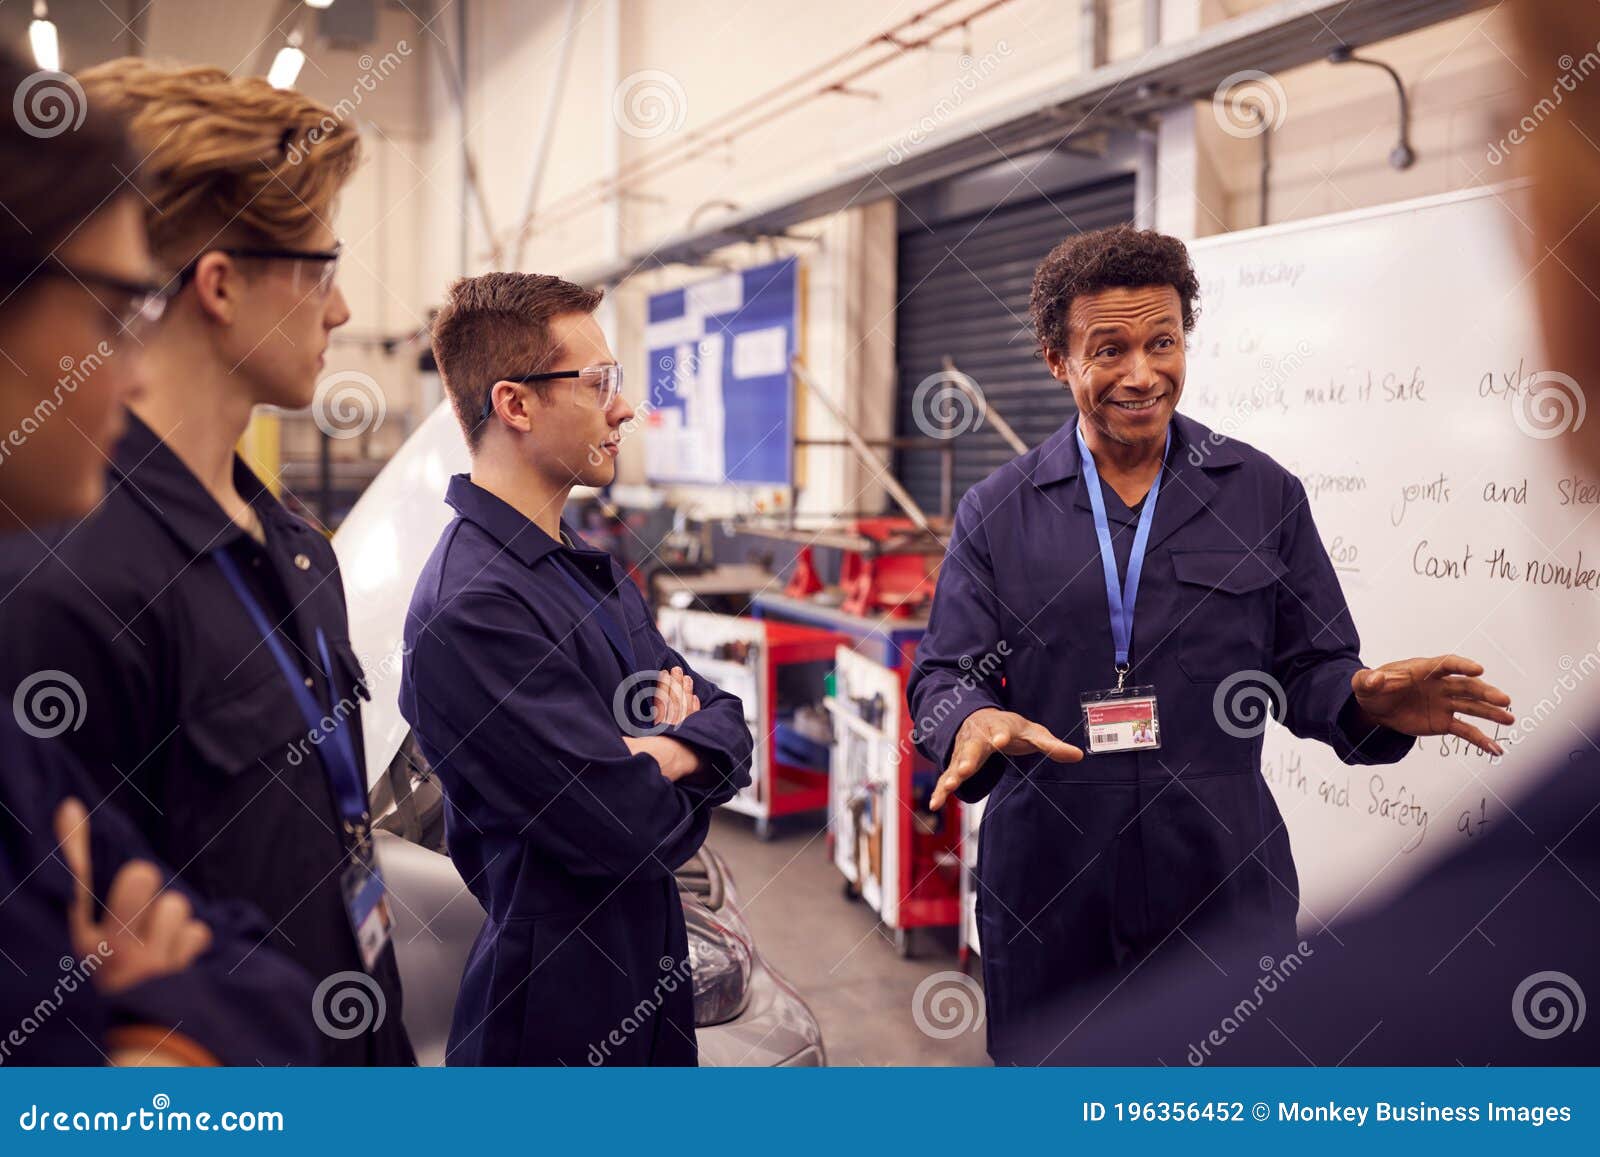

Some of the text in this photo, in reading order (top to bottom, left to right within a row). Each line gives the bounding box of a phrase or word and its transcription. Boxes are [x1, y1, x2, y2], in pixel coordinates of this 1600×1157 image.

[1382, 366, 1427, 402] Safe
[1479, 357, 1538, 400] axle
[1483, 479, 1527, 504] and
[1485, 548, 1520, 580] the
[1318, 775, 1350, 807] and
[1368, 773, 1429, 854] Safety
[1457, 797, 1490, 838] at
